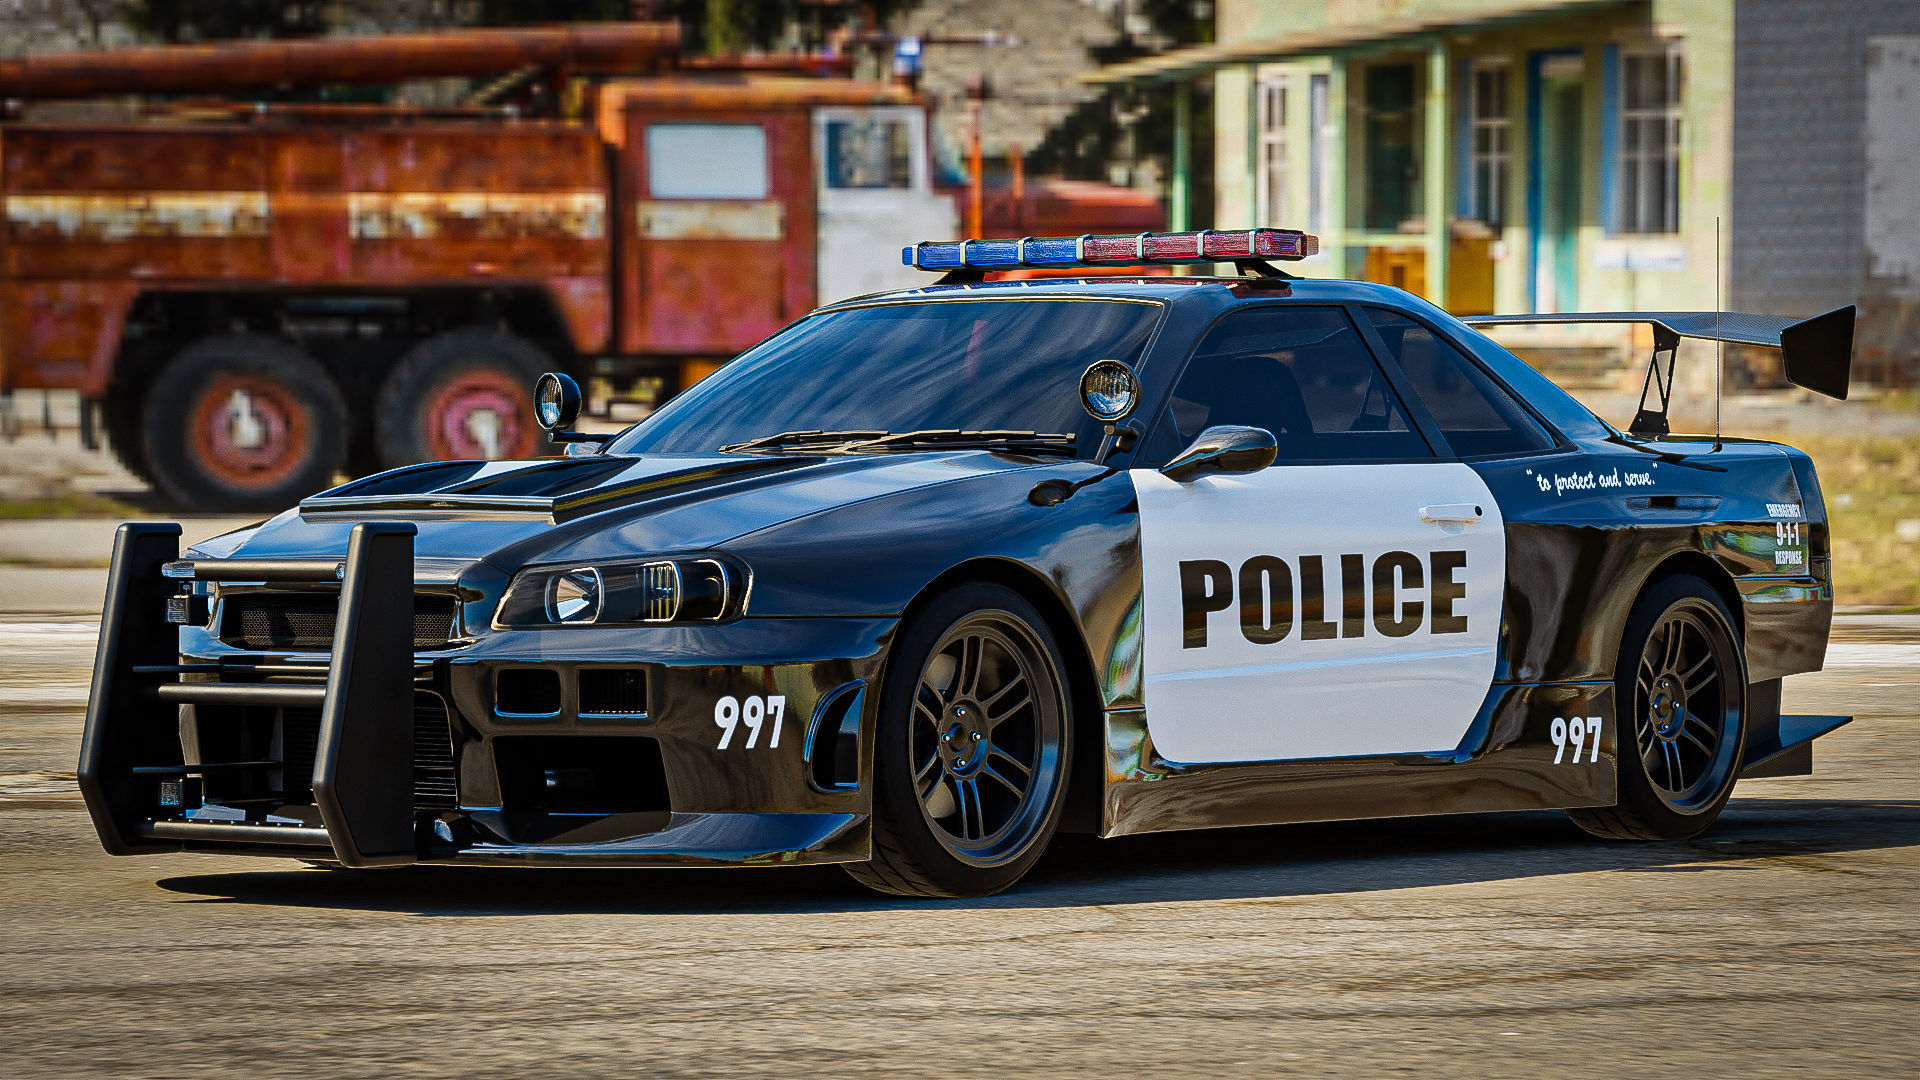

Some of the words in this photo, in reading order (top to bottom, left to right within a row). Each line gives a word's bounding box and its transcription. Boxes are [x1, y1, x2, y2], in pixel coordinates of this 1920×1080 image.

[1554, 471, 1596, 496] protect
[1599, 467, 1622, 487] and
[1766, 503, 1801, 518] EMERGENCY
[1776, 521, 1800, 546] 9-1-1
[1775, 550, 1803, 565] RESPONSE
[1178, 550, 1468, 649] POLICE
[714, 695, 786, 750] 997
[1550, 716, 1603, 765] 997
